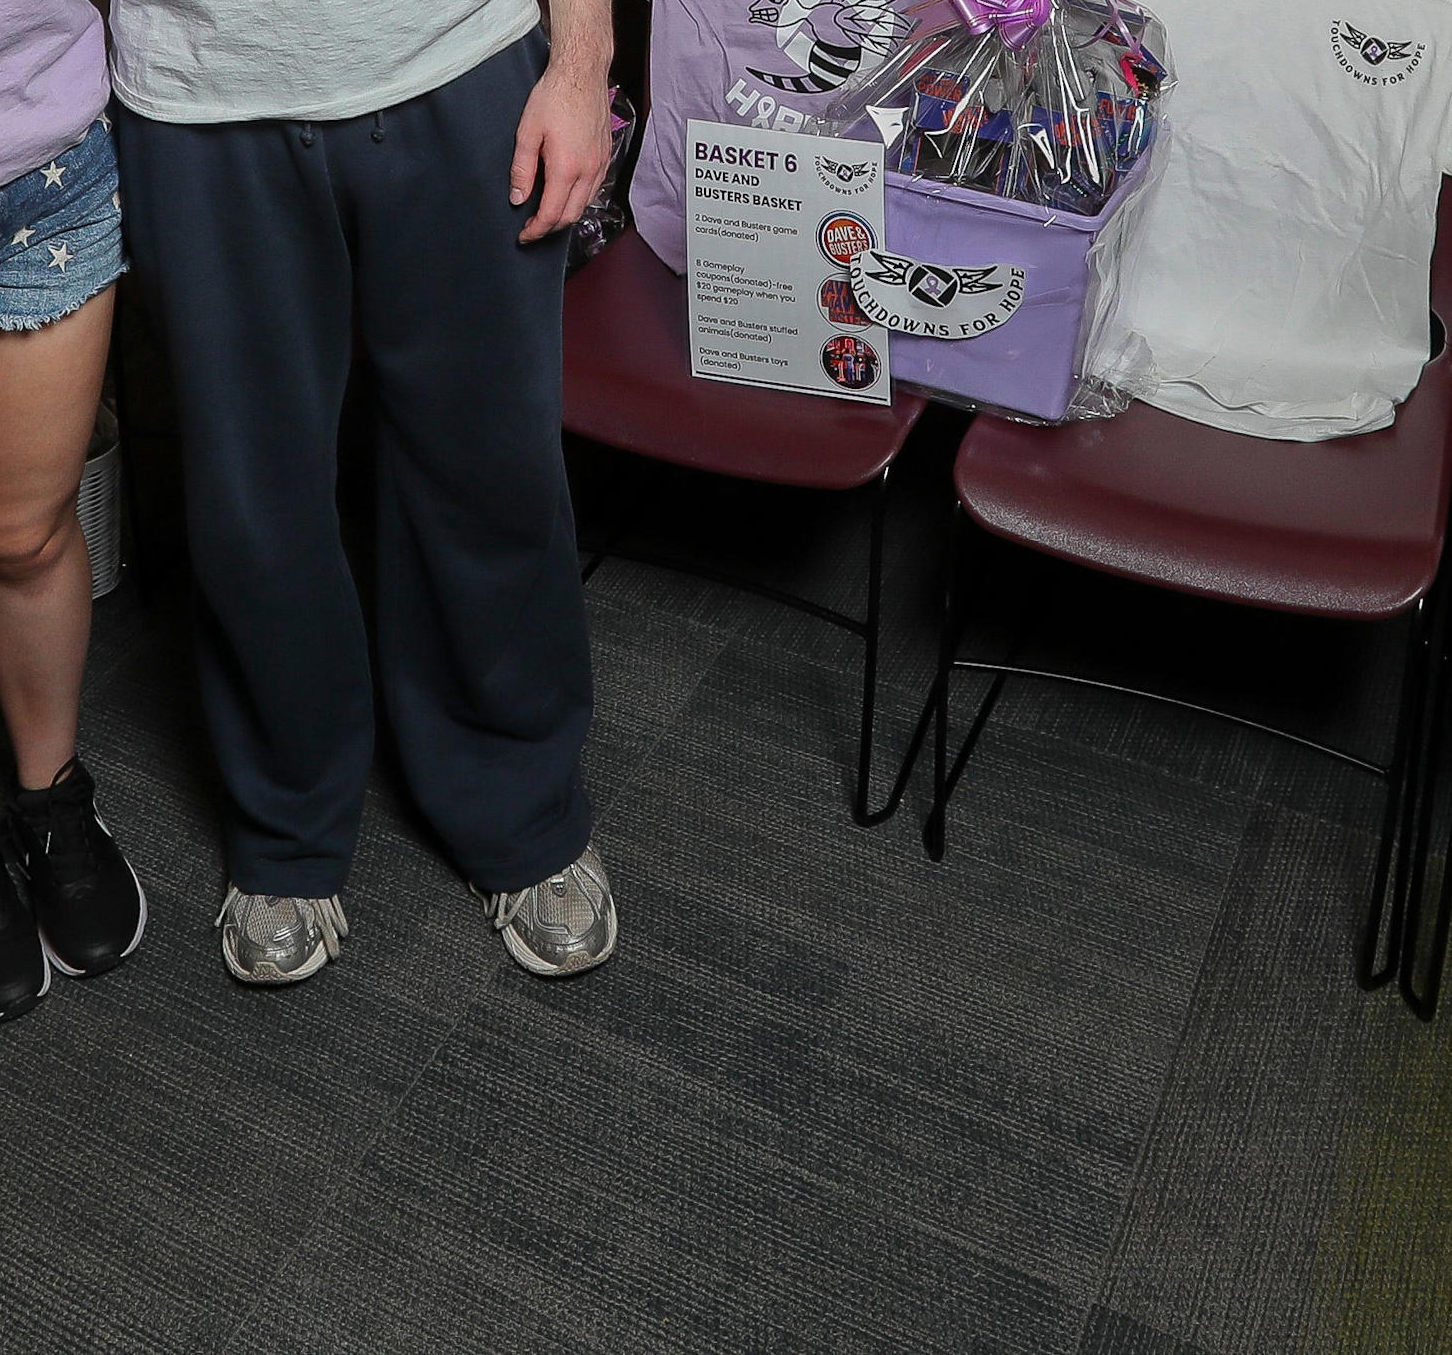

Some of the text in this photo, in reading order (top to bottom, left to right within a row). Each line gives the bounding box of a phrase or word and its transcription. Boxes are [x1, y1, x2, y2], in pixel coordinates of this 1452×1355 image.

[1331, 20, 1426, 86] TOUCHDOWNS FOR HOPE
[695, 142, 798, 173] BASKET 6
[695, 168, 760, 187] DAVE AND
[695, 186, 802, 211] BUSTERS BASKET
[695, 226, 759, 242] cards(donated)
[701, 214, 722, 225] Dave
[723, 218, 740, 228] and
[741, 220, 772, 232] Busters
[772, 226, 798, 236] game
[827, 226, 866, 243] DAVE &
[696, 281, 796, 305] $20 gameplay when you
[697, 294, 738, 306] spend $20
[850, 253, 950, 336] TOUCHDOWNS
[959, 313, 1001, 335] FOR
[999, 268, 1025, 313] HOPE
[697, 314, 798, 336] Dave and Busters stuffed
[698, 326, 772, 343] animals(donated)
[699, 347, 789, 367] Dave and Busters toys
[700, 357, 741, 371] (donated)
